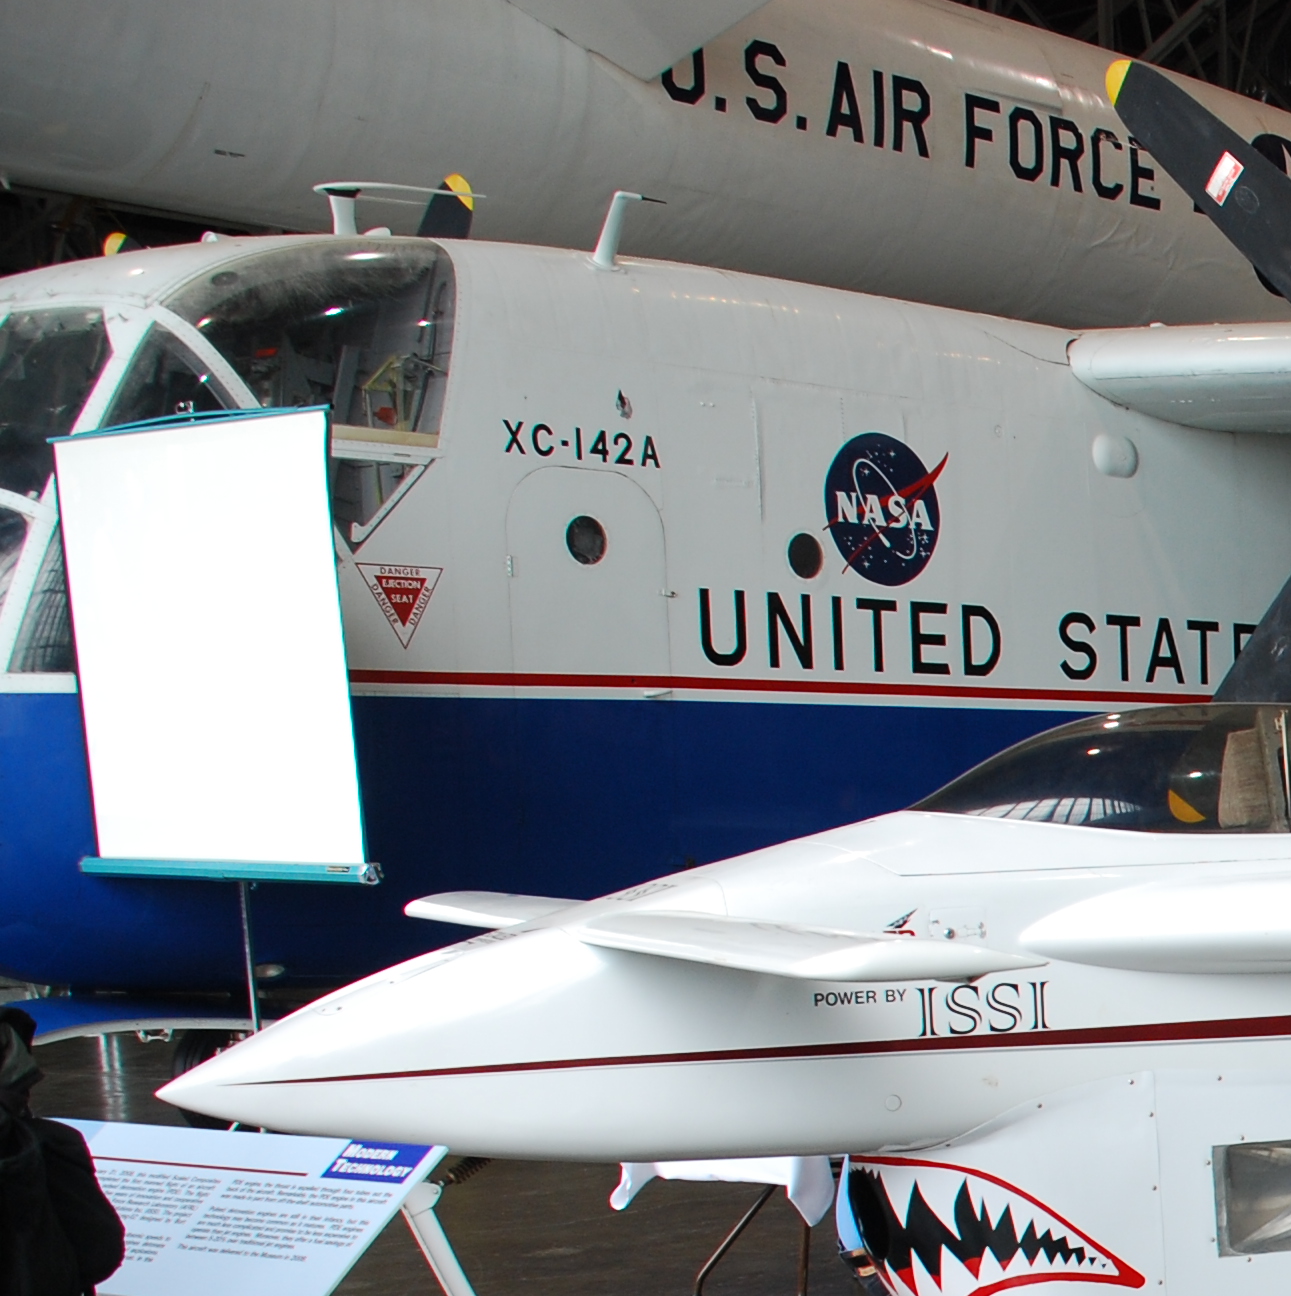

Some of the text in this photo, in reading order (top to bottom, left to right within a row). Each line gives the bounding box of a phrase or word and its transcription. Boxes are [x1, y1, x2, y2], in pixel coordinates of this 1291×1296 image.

[660, 39, 1162, 211] U.S. AIR FORCE
[502, 418, 661, 469] XC-142A
[834, 489, 935, 532] NASA
[380, 566, 421, 577] DANGER
[382, 578, 422, 590] EJECTION
[370, 583, 400, 626] DANGER
[390, 594, 414, 604] SEAT
[408, 586, 433, 627] DANGER
[698, 586, 1002, 677] UNITED
[1058, 611, 1258, 685] STAT
[814, 980, 1051, 1038] POWER BY ISSI
